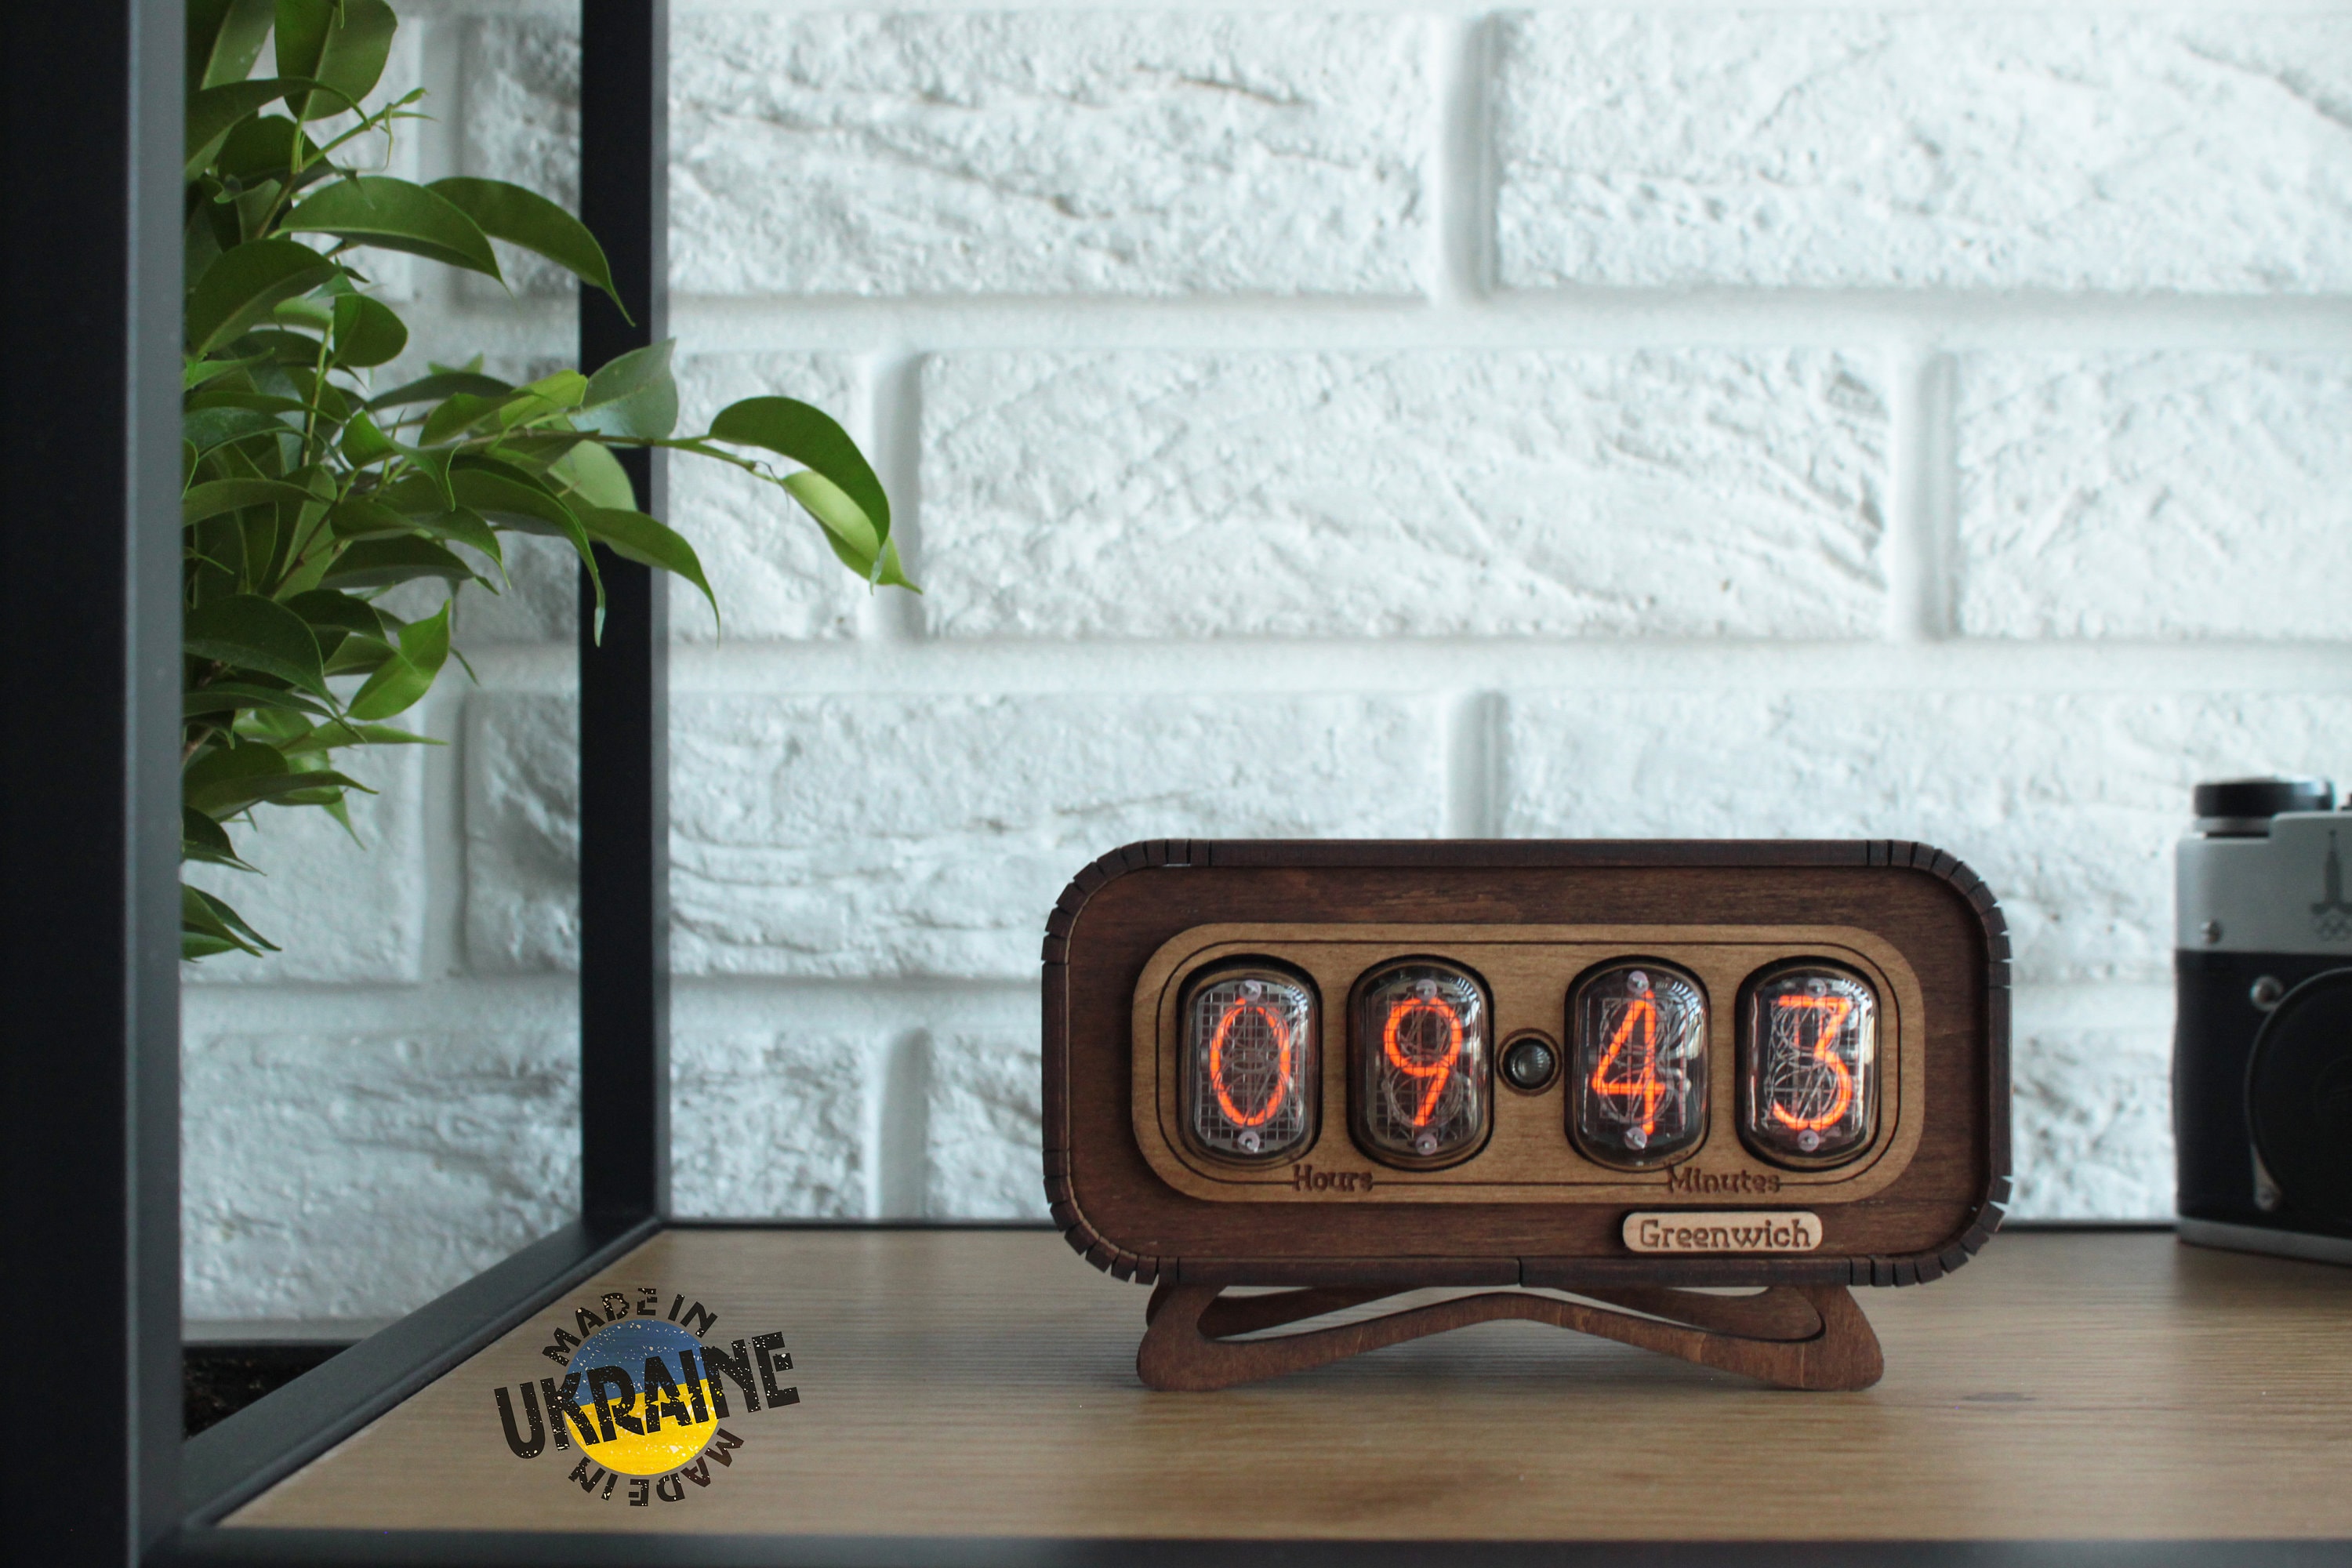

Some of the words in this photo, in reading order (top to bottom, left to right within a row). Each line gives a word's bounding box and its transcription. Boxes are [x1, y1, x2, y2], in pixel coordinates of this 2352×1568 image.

[1293, 1166, 1373, 1192] Hours
[1667, 1165, 1780, 1193] Minutes
[1640, 1219, 1809, 1249] Greenwich
